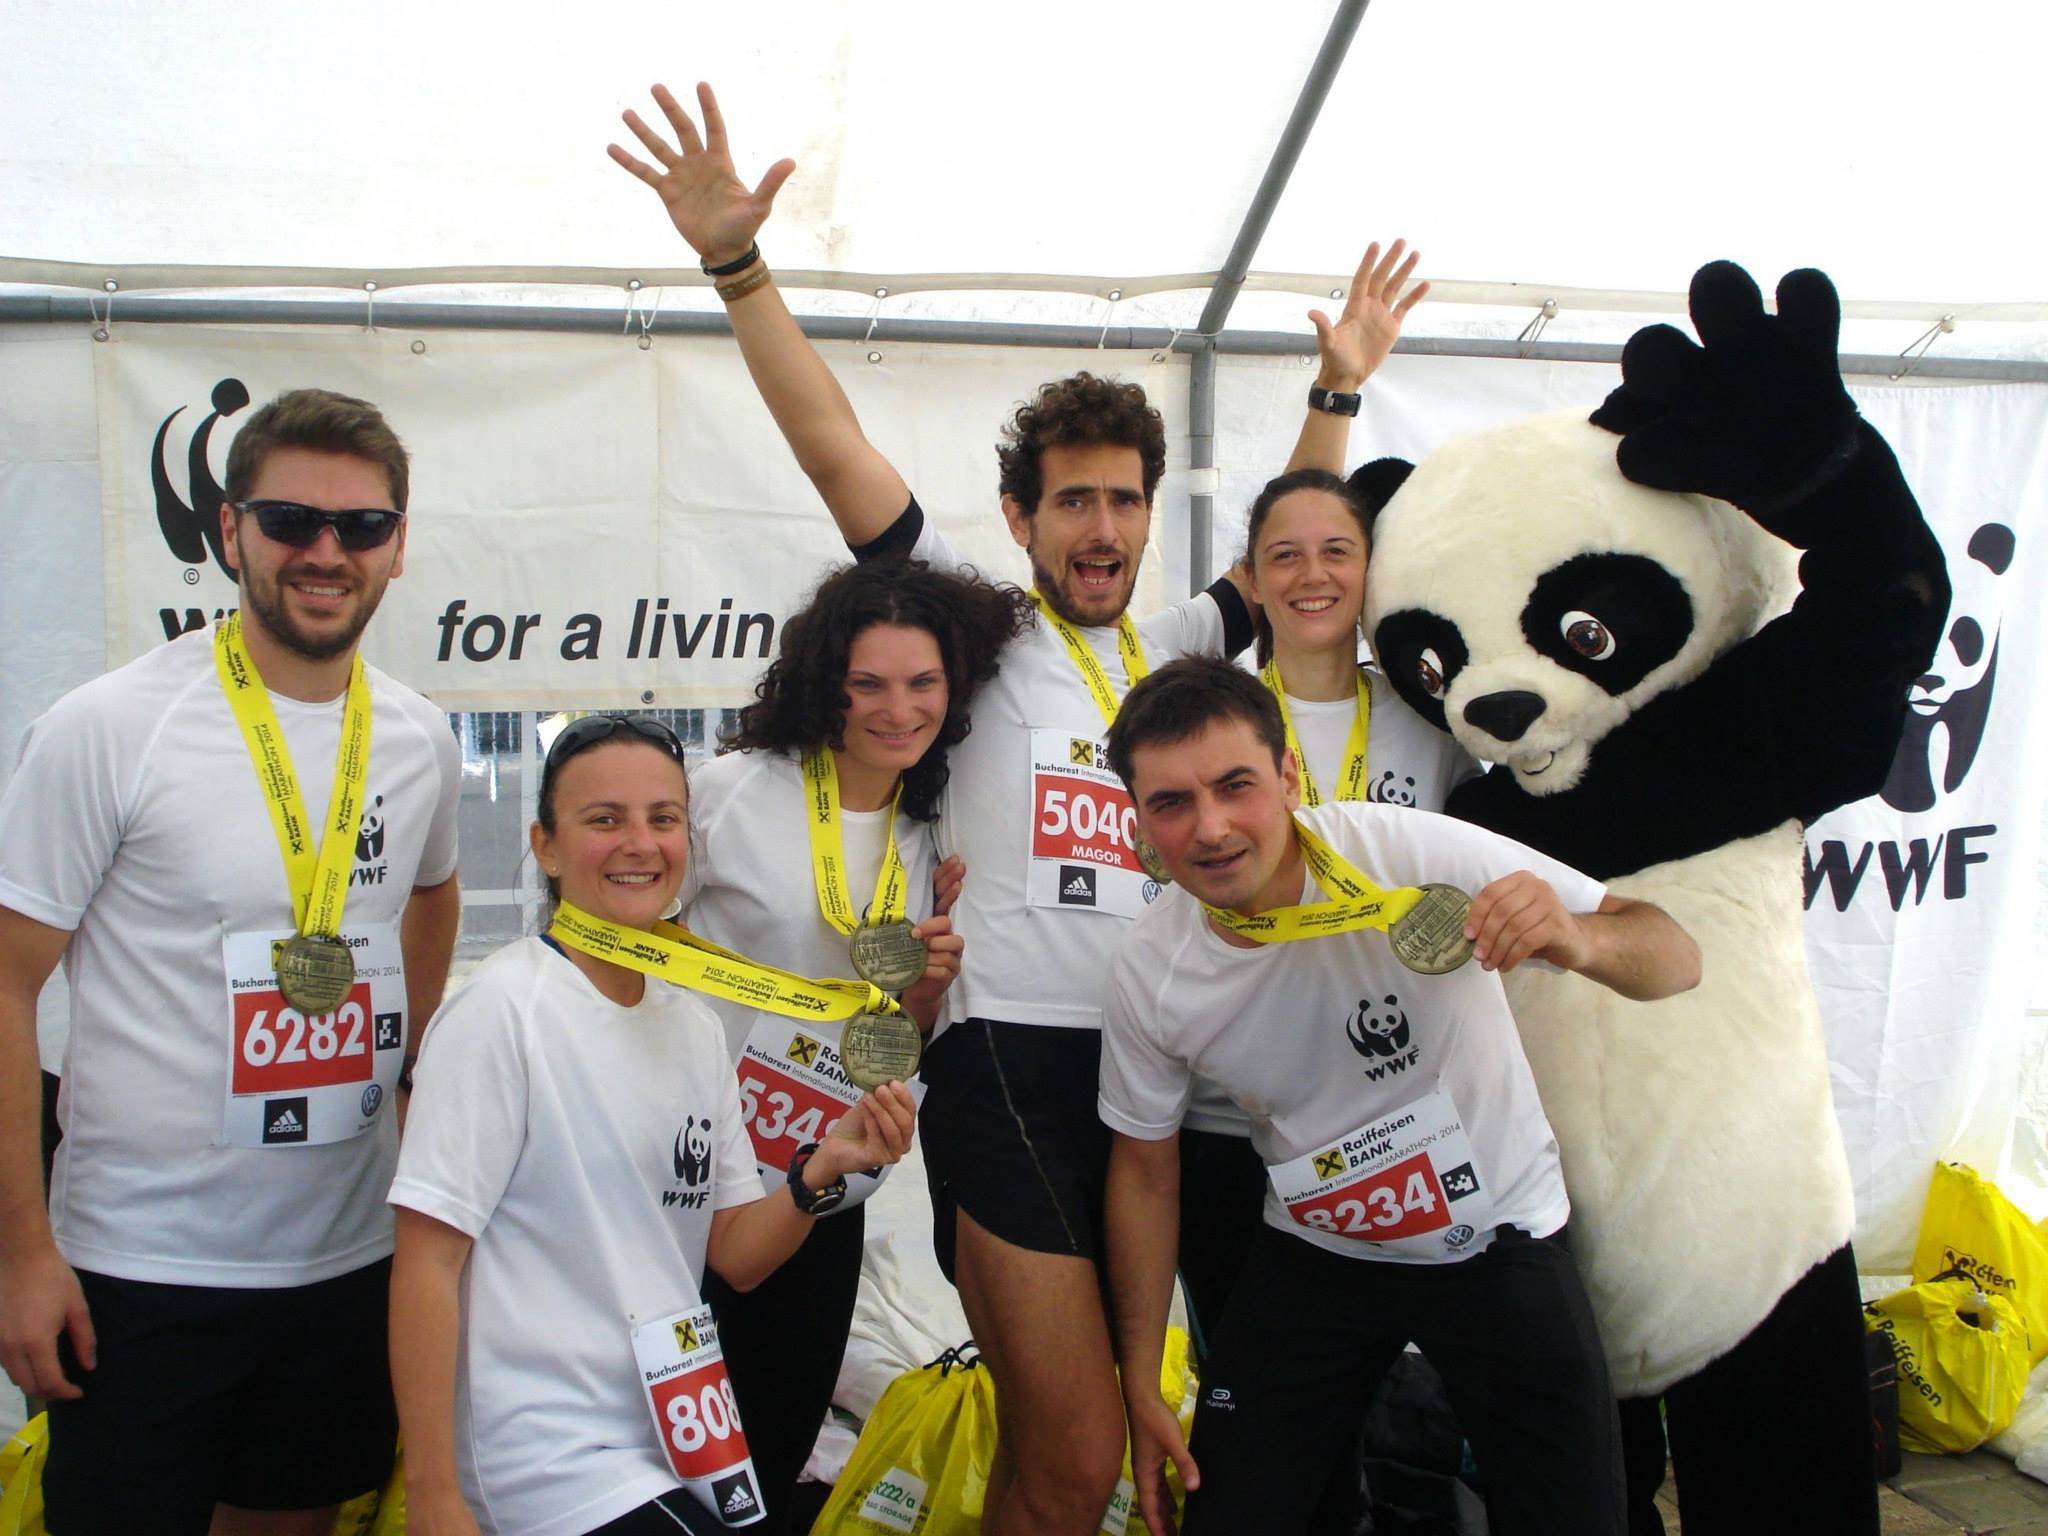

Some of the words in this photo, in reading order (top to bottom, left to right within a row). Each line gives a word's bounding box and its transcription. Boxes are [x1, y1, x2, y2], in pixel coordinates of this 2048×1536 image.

[437, 599, 541, 662] for
[559, 613, 600, 660] a
[626, 598, 775, 660] livin
[1034, 762, 1080, 776] Bucharest
[1081, 768, 1120, 786] International
[1071, 845, 1122, 865] MAGOR
[1803, 824, 1997, 912] WWF
[1064, 887, 1092, 897] adidas
[573, 922, 619, 943] MARATHON
[582, 933, 615, 950] Bucharest
[619, 944, 655, 963] Raiffeisen
[633, 941, 657, 955] BANK
[232, 978, 278, 989] Buchares
[352, 967, 381, 979] ATHON
[382, 966, 401, 977] 2014
[705, 966, 726, 979] 2014
[727, 972, 776, 993] MARATHON
[736, 983, 772, 1000] Bucharest
[791, 992, 817, 1004] BANK
[775, 995, 814, 1011] Raiffeisen
[243, 1002, 366, 1067] 6282
[746, 1044, 791, 1072] Bucharest
[791, 1066, 838, 1095] International
[1364, 1048, 1420, 1082] WWF
[740, 1076, 841, 1148] 534
[269, 1124, 303, 1133] adidas
[1342, 1112, 1416, 1155] Raiffeisen
[1284, 1182, 1334, 1203] Bucharest
[1335, 1160, 1385, 1187] International
[1385, 1133, 1437, 1164] MARATHON
[1440, 1122, 1461, 1140] 2014
[1349, 1139, 1394, 1168] BANK
[662, 1191, 710, 1209] WWF
[1303, 1171, 1436, 1234] 8234
[699, 1328, 718, 1347] BAN
[646, 1357, 693, 1381] Bucharest
[1876, 1320, 1943, 1408] Raiffeisen
[724, 1497, 754, 1514] adidas
